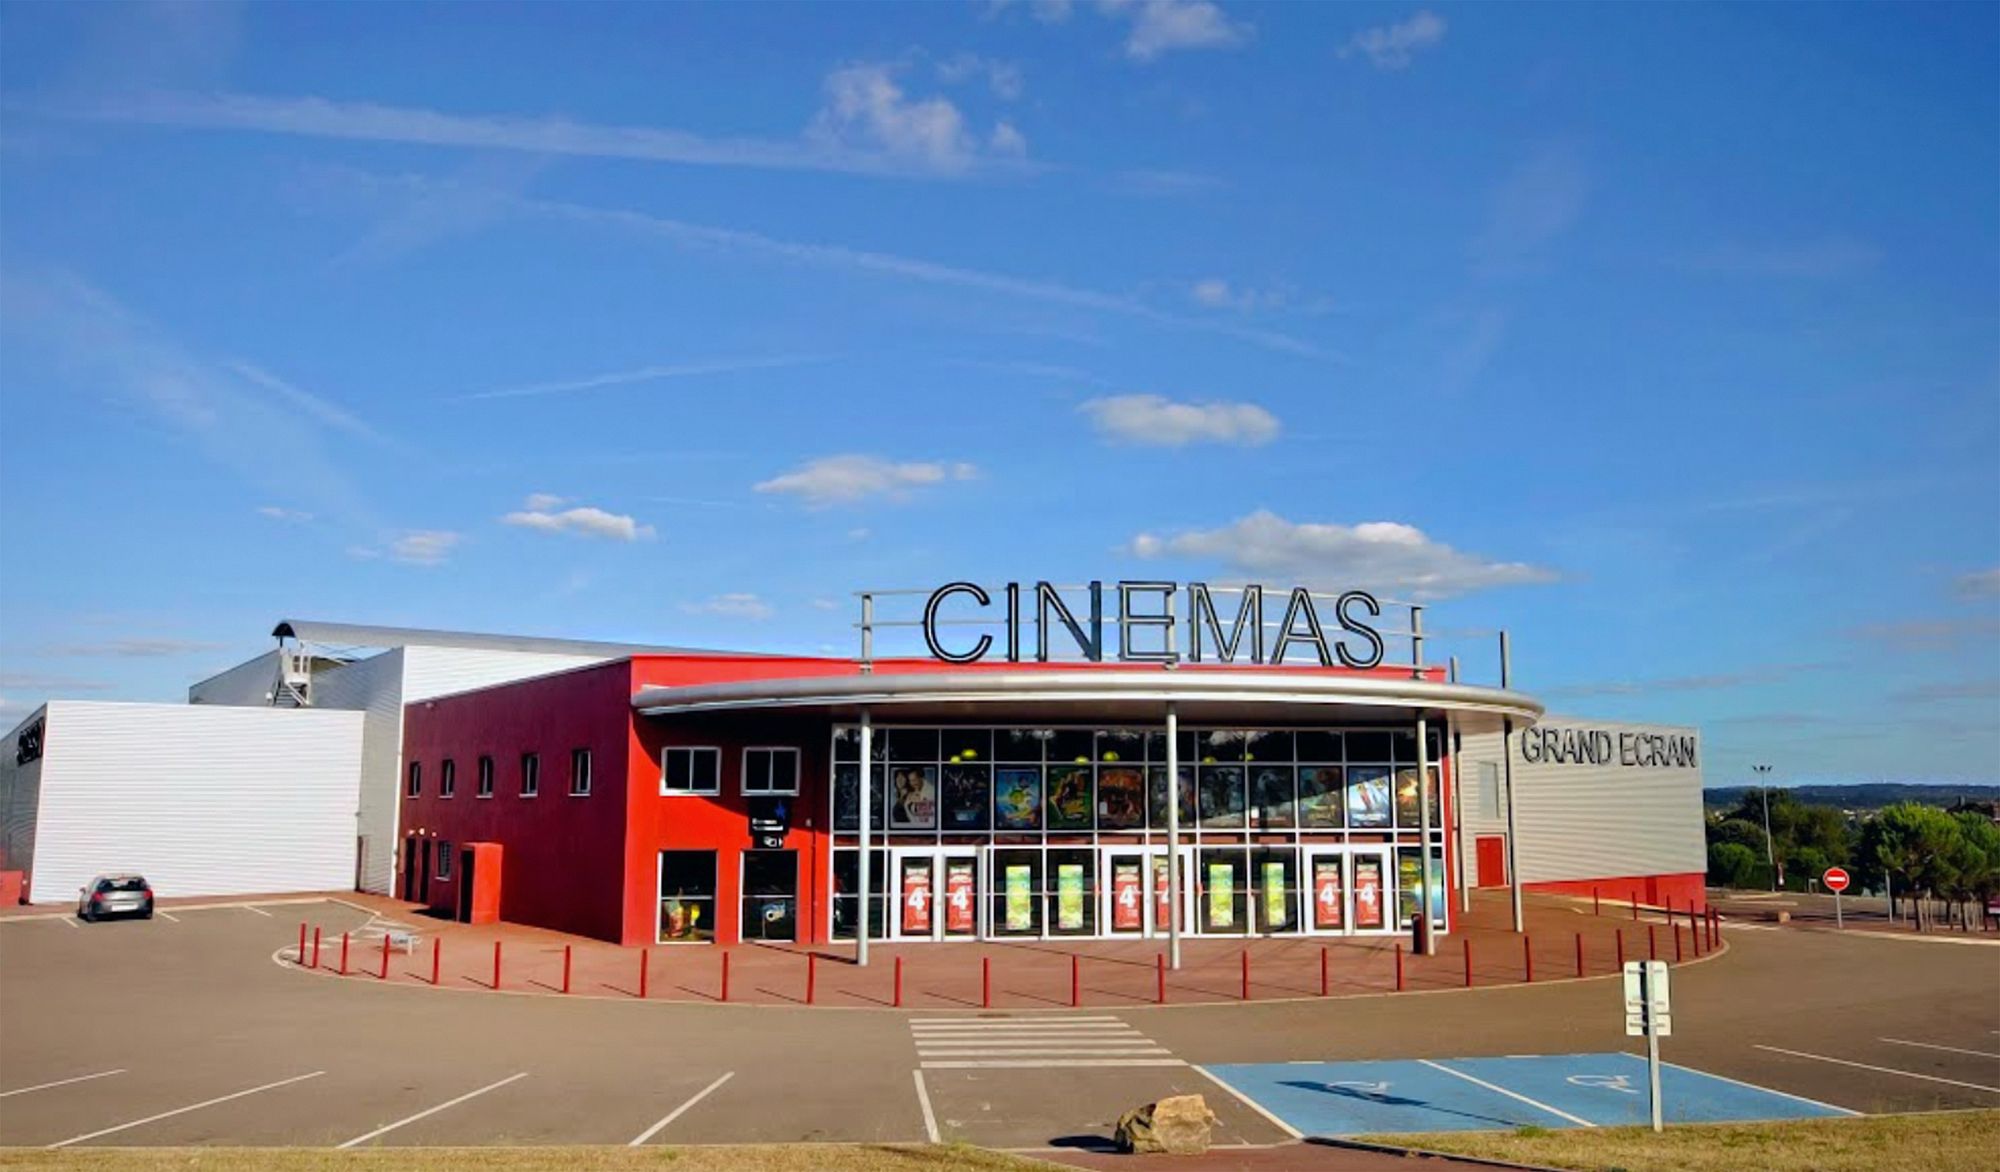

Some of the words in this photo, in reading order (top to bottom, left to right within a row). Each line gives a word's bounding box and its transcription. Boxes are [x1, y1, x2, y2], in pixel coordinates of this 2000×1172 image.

[924, 581, 1384, 669] CINEMAS
[1522, 727, 1612, 765] GRAND
[1620, 732, 1697, 768] ECRAN
